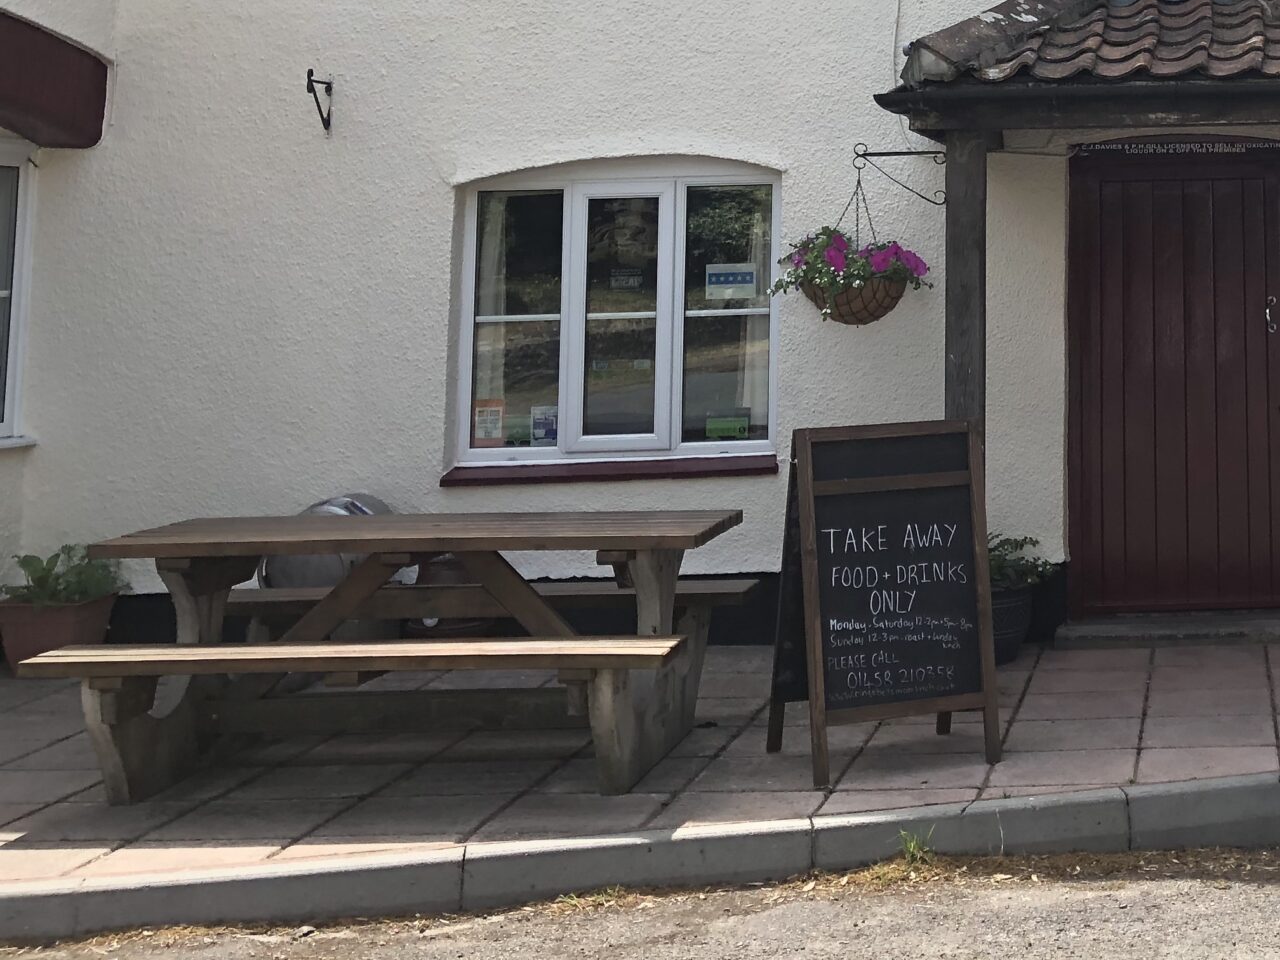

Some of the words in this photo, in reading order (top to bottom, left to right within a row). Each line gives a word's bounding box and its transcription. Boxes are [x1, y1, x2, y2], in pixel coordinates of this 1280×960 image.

[821, 525, 888, 554] TAKE
[903, 523, 957, 549] AWAY
[831, 566, 879, 589] FOOD
[897, 562, 967, 586] DRINKS
[869, 590, 916, 615] ONLY
[830, 618, 867, 633] Monday
[872, 616, 914, 630] Saturday
[830, 633, 864, 648] Sunday
[828, 654, 866, 671] PLEASE
[871, 650, 900, 667] CALL
